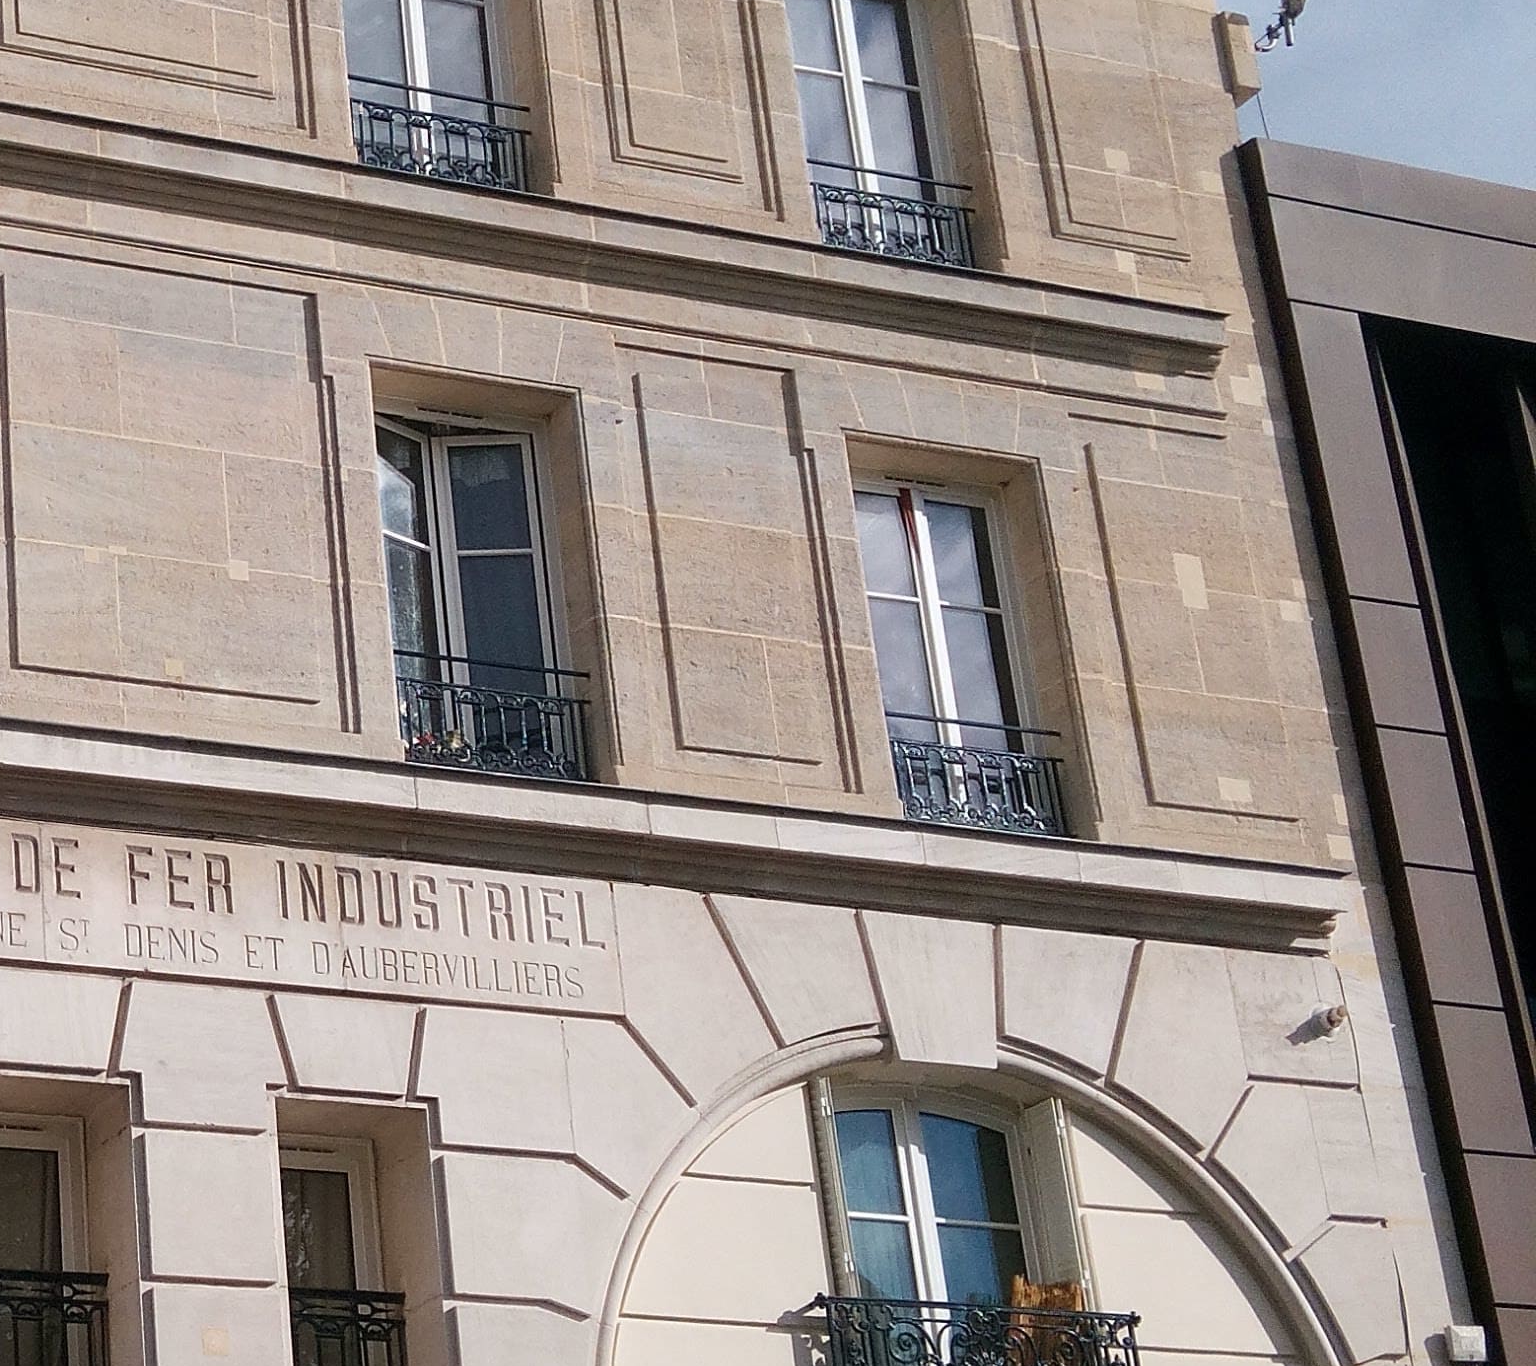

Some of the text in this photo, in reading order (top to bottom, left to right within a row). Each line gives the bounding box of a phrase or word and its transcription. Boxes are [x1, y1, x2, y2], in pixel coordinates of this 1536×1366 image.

[10, 832, 82, 900] DE
[125, 843, 235, 915] FER
[275, 859, 607, 951] INDUSTRIEL
[123, 922, 219, 966] DENIS
[243, 936, 284, 971] ET
[312, 940, 586, 999] D'AUBERVILLIERS
